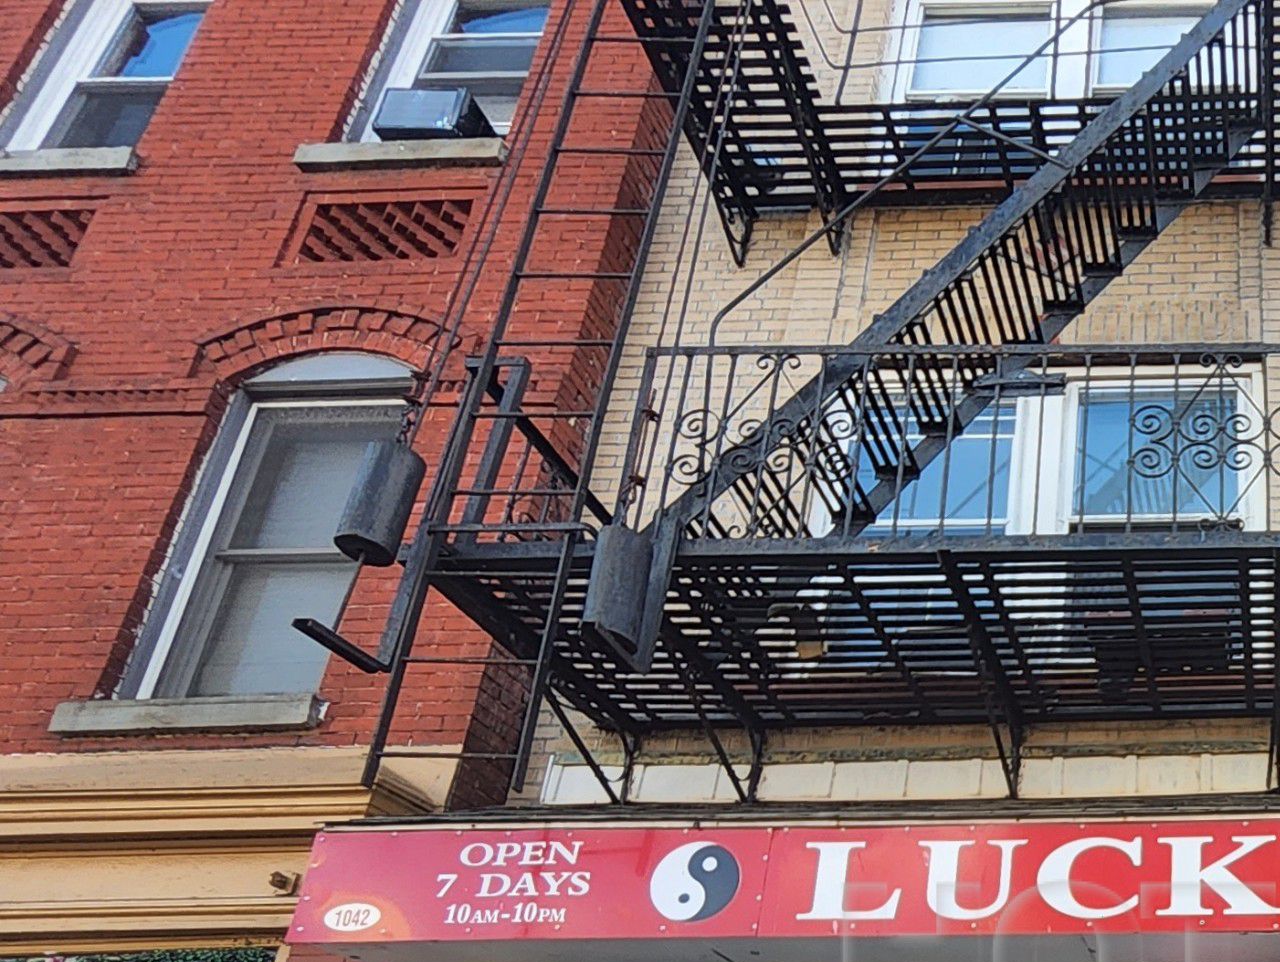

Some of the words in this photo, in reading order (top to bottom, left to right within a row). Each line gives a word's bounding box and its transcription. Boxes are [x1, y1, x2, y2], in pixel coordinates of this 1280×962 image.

[460, 841, 584, 866] OPEN
[436, 873, 458, 898] 7
[475, 872, 591, 898] DAYS
[334, 908, 371, 928] 1042
[444, 902, 566, 925] 10AM-10PM
